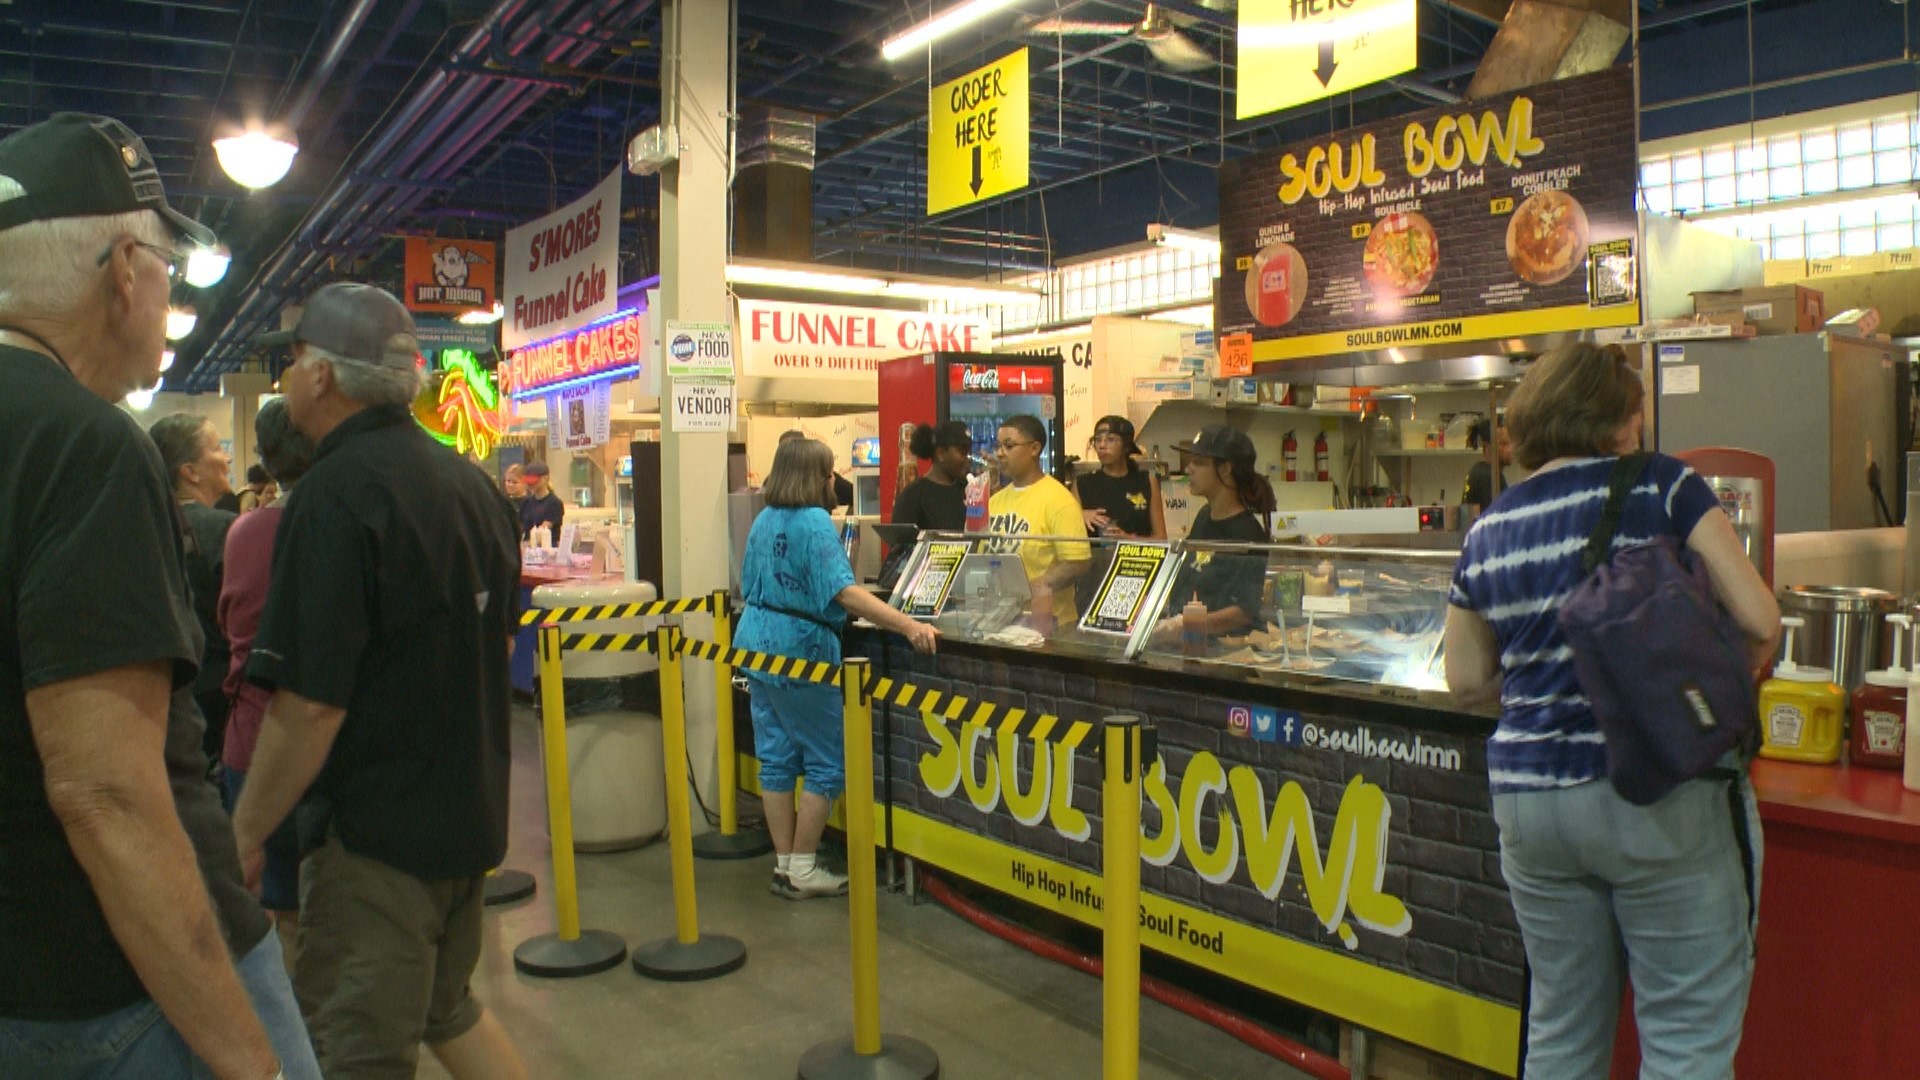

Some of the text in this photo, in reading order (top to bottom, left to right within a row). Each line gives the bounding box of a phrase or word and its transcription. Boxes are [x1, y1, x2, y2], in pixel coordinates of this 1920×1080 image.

[951, 68, 1007, 113] ORDER
[955, 107, 998, 149] HERE
[1278, 94, 1545, 205] SOUL BOWL
[1511, 165, 1581, 188] DONUT PEACH
[1523, 179, 1569, 196] COBBLER
[1370, 183, 1415, 205] Infused
[1420, 176, 1450, 194] Soul
[529, 199, 602, 272] S'MORES
[1255, 231, 1295, 248] LEMONADE
[1259, 225, 1283, 237] QUEEN
[514, 262, 606, 333] Funnel Cake
[701, 331, 726, 339] NEW
[752, 309, 979, 353] FUNNEL CAKE
[1346, 322, 1463, 347] SOULBOWLMN.COM
[512, 338, 573, 386] FUNNEL
[575, 316, 639, 373] CAKES
[673, 343, 692, 355] YUM
[698, 340, 729, 358] FOOD
[774, 353, 809, 368] OVER
[814, 355, 823, 368] 9
[1226, 353, 1248, 368] 426
[678, 396, 731, 414] VENDOR
[930, 544, 946, 554] SOUL
[1119, 545, 1166, 558] SOUL BOWL
[1302, 722, 1461, 771] @soulbowlmn
[919, 706, 1090, 842] SOUL
[1011, 860, 1223, 954] Hip Hop Infu Soul Food
